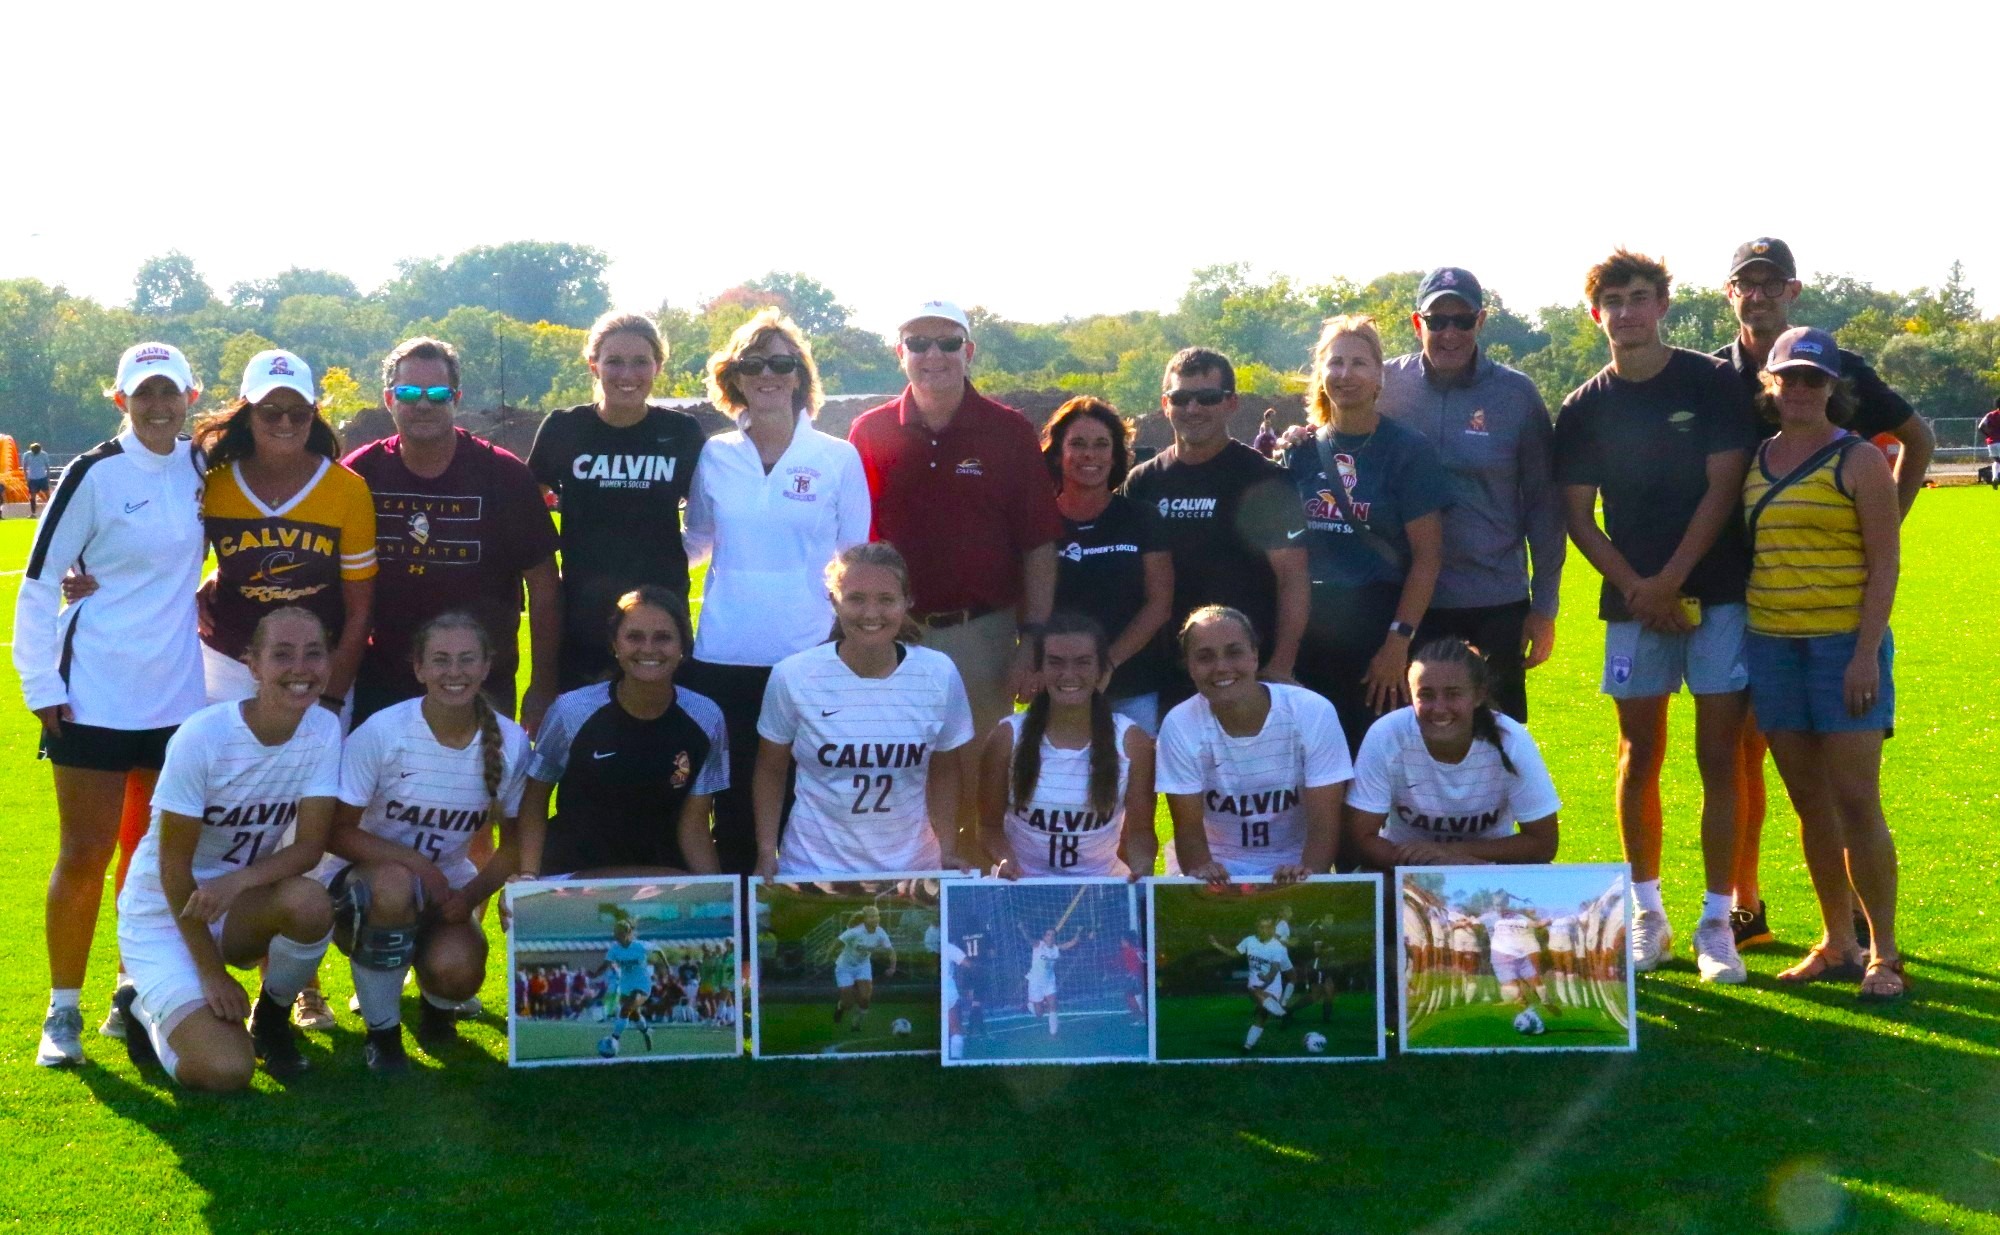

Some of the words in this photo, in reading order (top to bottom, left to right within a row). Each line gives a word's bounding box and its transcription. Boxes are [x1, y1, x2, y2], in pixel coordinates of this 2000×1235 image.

[135, 347, 170, 358] CALVIN
[572, 454, 677, 482] CALVIN
[383, 500, 461, 513] CALVIN
[1171, 498, 1217, 510] CALVIN
[220, 528, 334, 557] CALVIN
[1083, 546, 1114, 555] WOMEN'S
[1116, 544, 1138, 552] SOCCER
[818, 742, 927, 769] CALVIN
[851, 774, 893, 814] 22
[1206, 785, 1300, 817] CALVIN
[202, 801, 298, 827] CALVIN
[386, 800, 489, 832] CALVIN
[1396, 805, 1500, 833] CALVIN
[1241, 821, 1270, 847] 19
[221, 831, 265, 866] 21
[1049, 833, 1079, 868] 18
